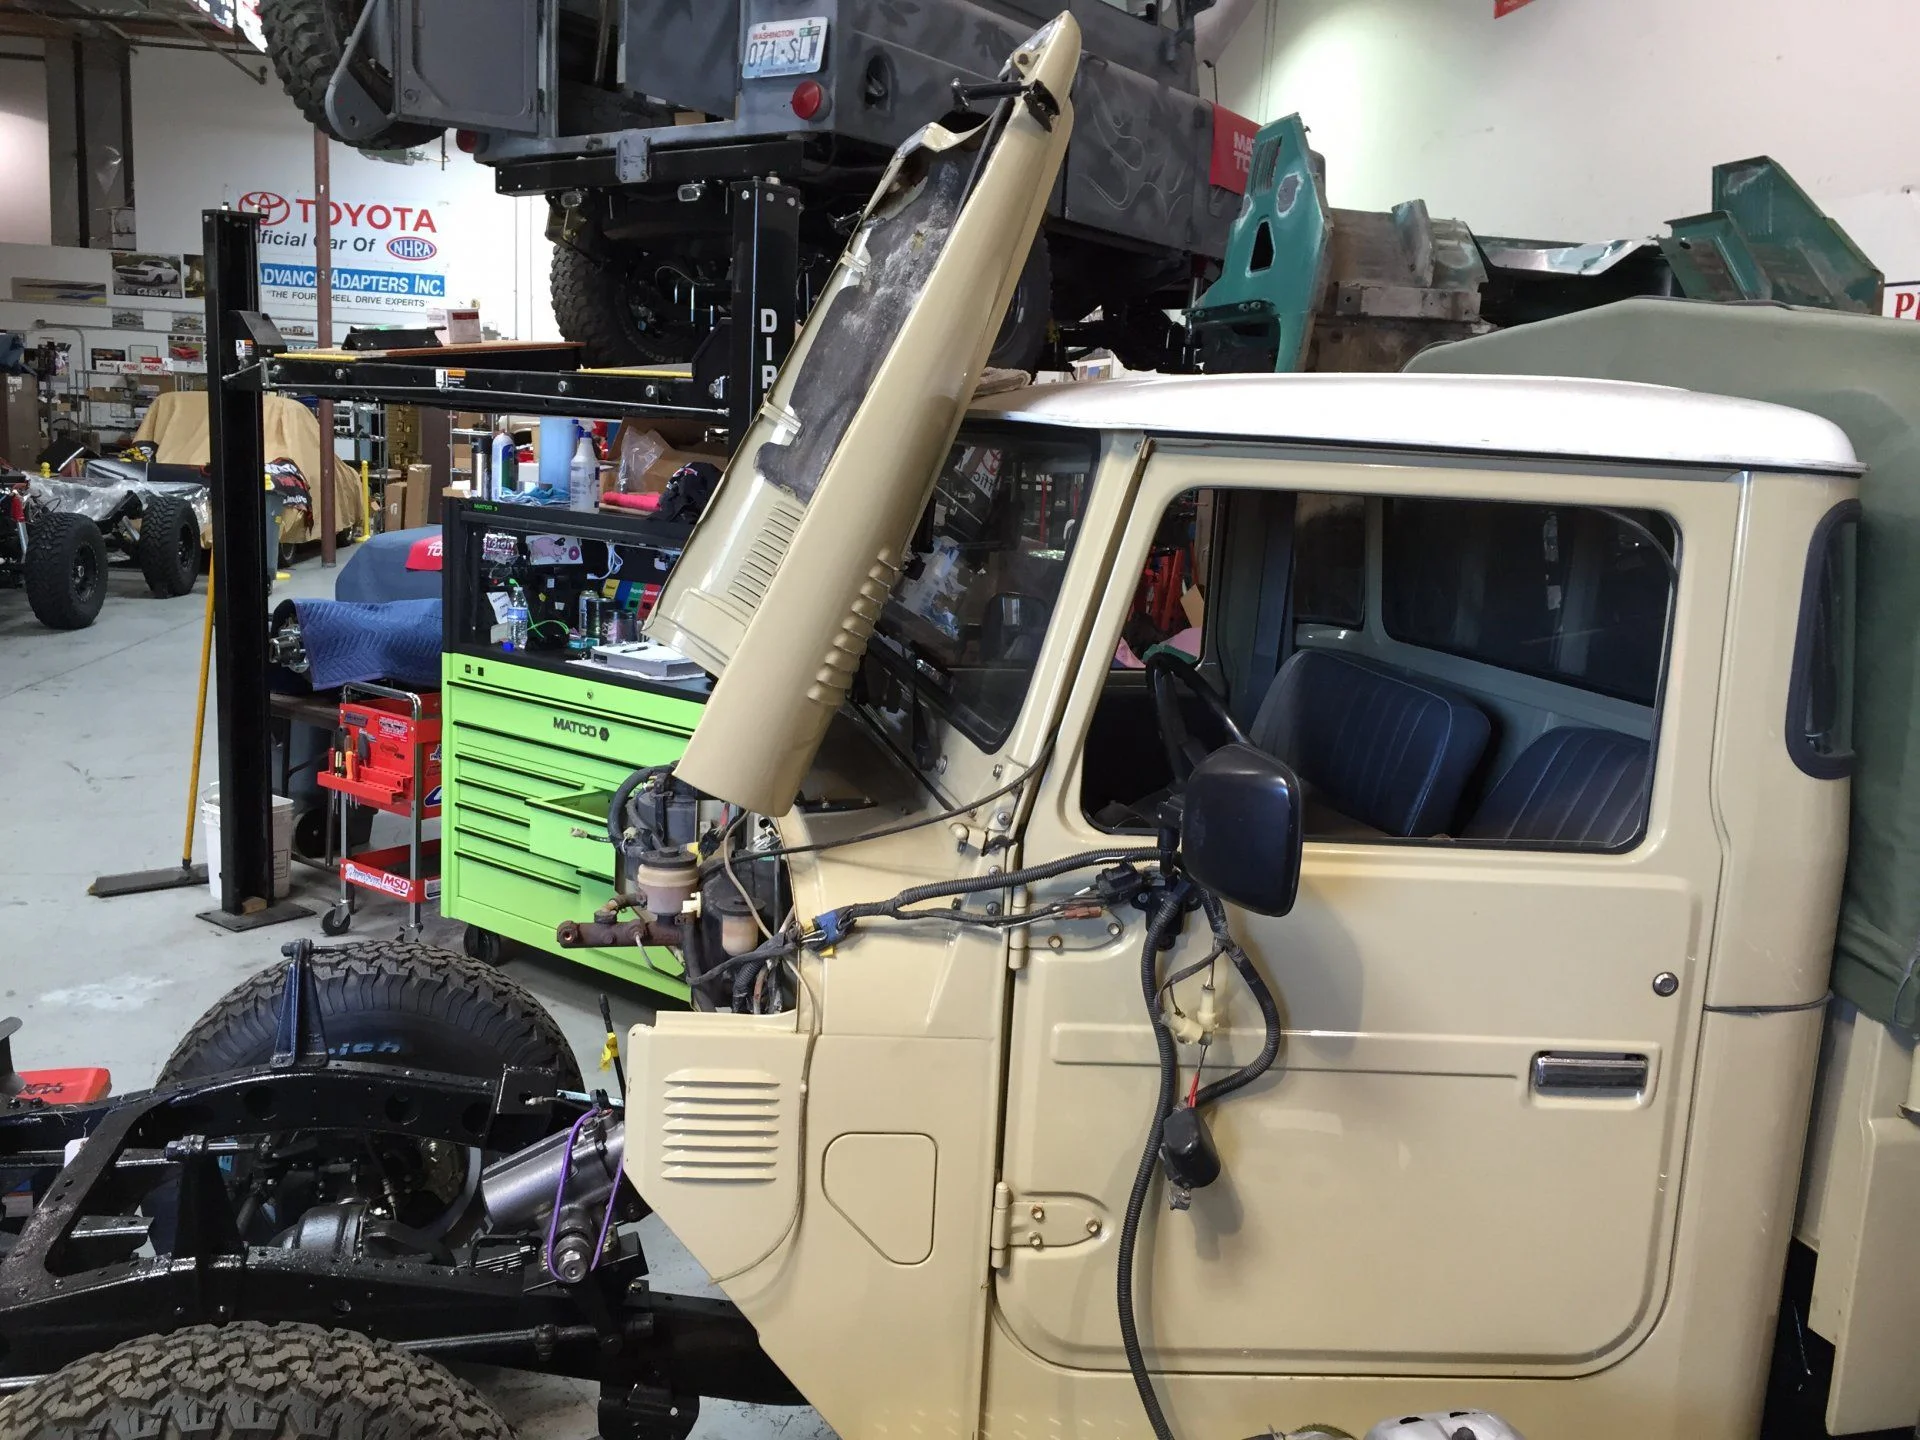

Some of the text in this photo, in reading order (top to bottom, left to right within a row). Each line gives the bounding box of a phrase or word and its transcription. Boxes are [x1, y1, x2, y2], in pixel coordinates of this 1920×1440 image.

[295, 198, 437, 233] TOYOTA
[353, 237, 376, 252] Of
[393, 240, 430, 256] NHRA
[331, 269, 408, 293] ADAPTERS
[414, 274, 444, 295] INC.
[292, 291, 317, 301] FOUR
[329, 294, 350, 303] HEEL
[355, 295, 382, 305] DRIVE
[553, 716, 597, 738] MATCO
[383, 875, 409, 891] MSD
